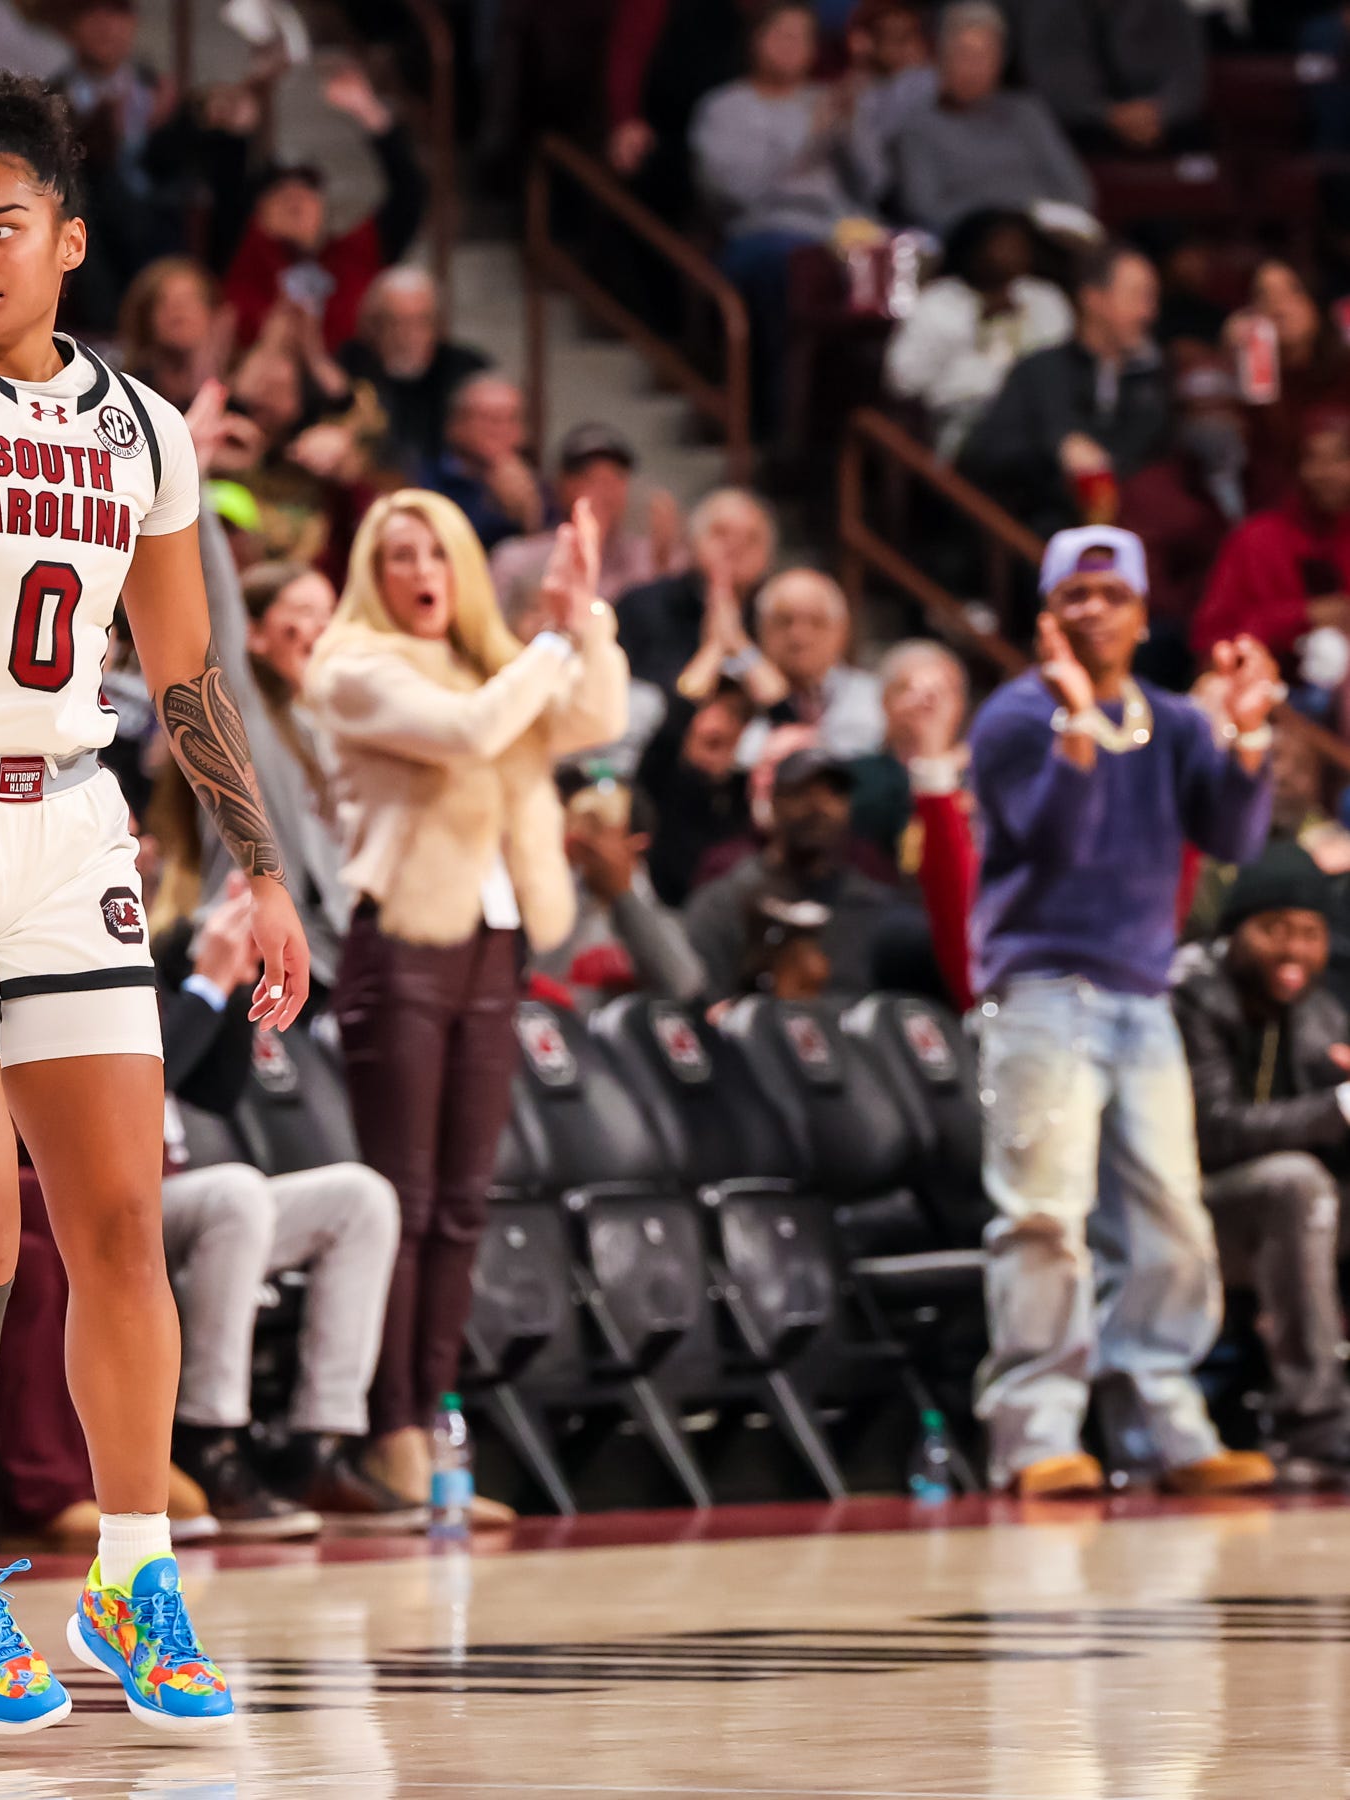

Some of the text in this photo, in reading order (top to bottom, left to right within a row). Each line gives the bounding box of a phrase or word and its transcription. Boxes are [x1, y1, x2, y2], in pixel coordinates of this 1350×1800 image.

[101, 407, 134, 445] SEC
[102, 436, 140, 457] GRADUATE
[8, 560, 83, 693] 0
[4, 771, 41, 783] CAROLINA
[9, 782, 34, 793] SOUTH
